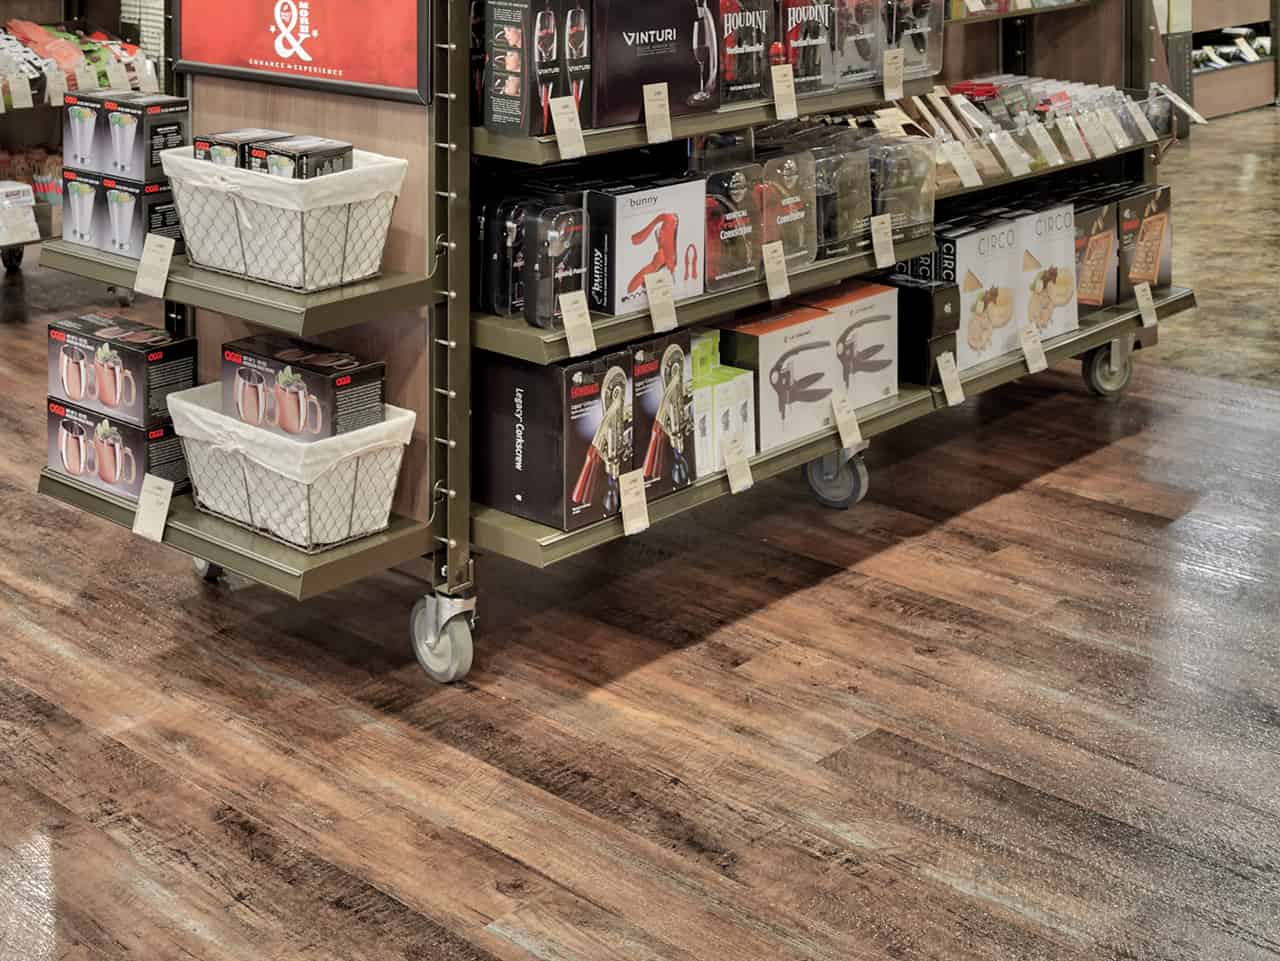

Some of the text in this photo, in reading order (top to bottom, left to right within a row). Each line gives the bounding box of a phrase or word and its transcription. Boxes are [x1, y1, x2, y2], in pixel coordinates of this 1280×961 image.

[722, 9, 769, 38] HOUDINI
[786, 3, 832, 32] HOUDINI
[623, 28, 677, 46] VINTURI
[629, 195, 659, 207] bunny
[1034, 212, 1074, 237] CIRCO
[977, 229, 1016, 256] CIRCO
[591, 248, 603, 291] bunny
[943, 243, 954, 281] CIRC
[513, 423, 525, 471] Corkscrew
